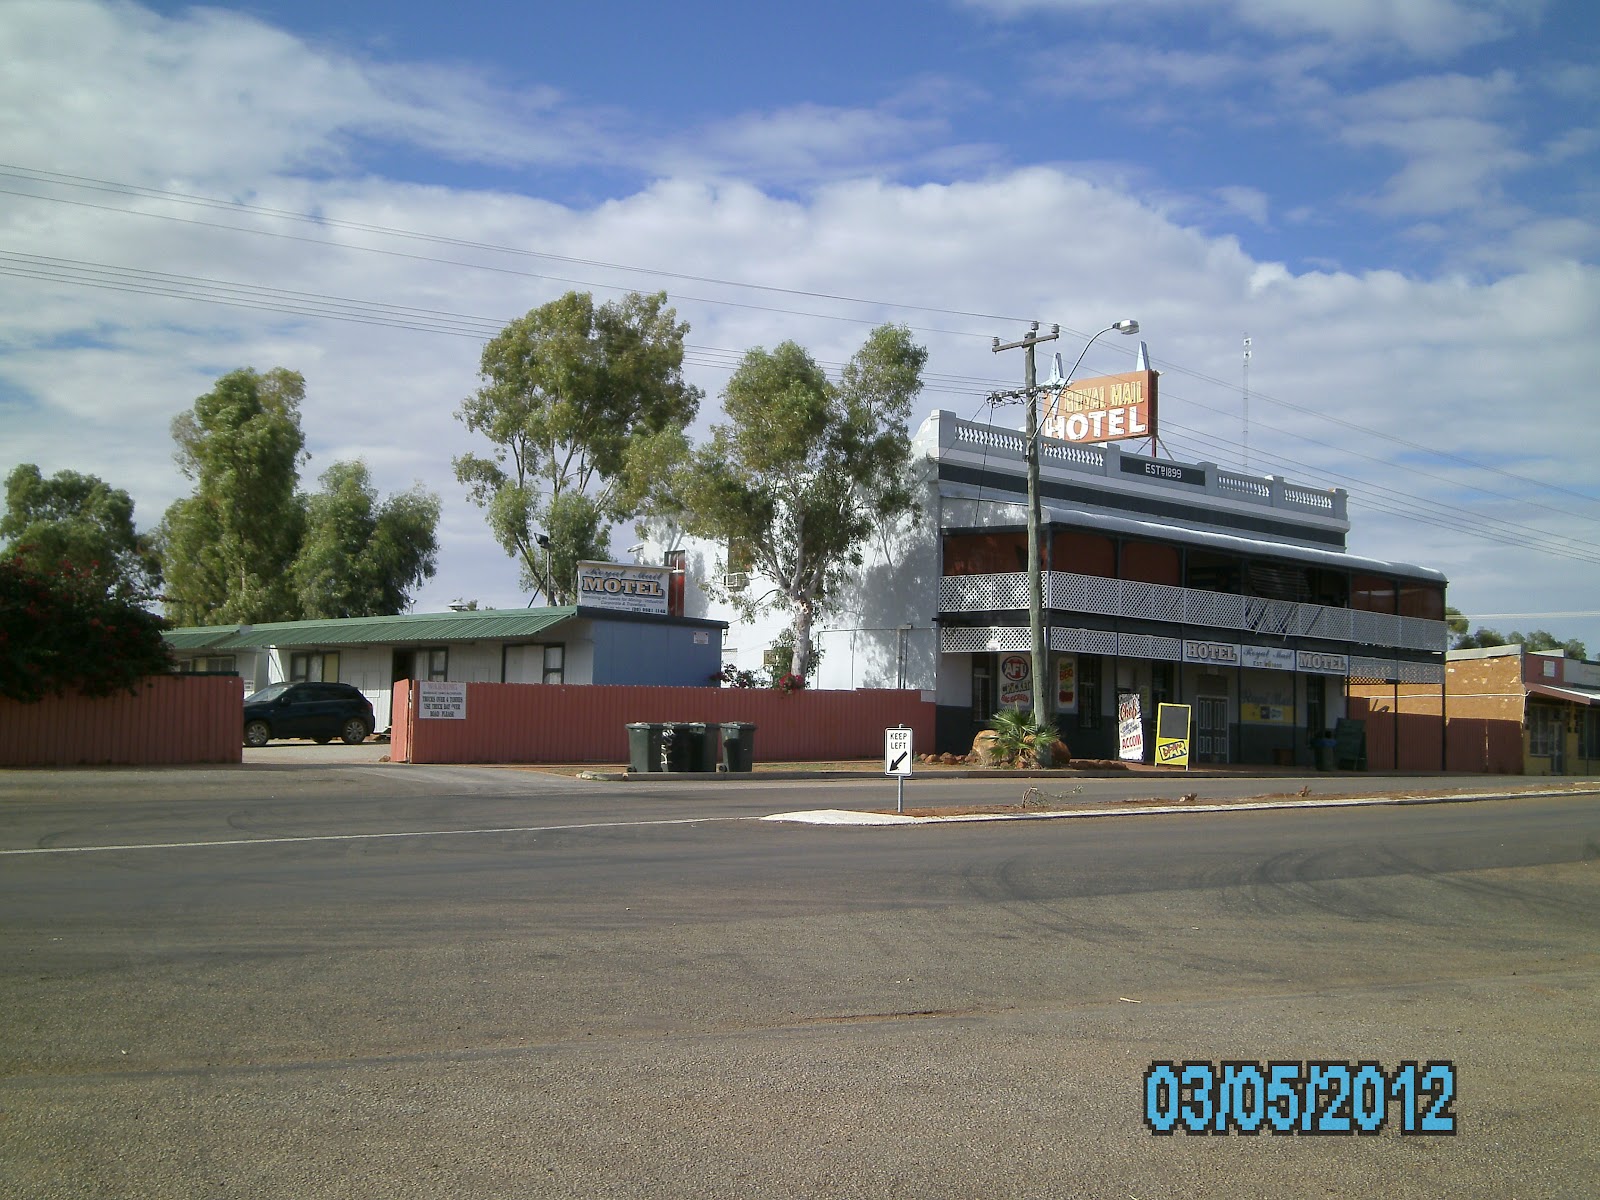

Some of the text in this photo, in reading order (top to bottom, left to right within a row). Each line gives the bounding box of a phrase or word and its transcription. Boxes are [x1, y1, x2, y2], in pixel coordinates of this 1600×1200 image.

[1065, 380, 1144, 412] ROYAL MAIL
[1044, 406, 1146, 440] HOTEL
[582, 576, 664, 598] MOTEL
[1186, 642, 1237, 661] HOTEL
[1004, 662, 1027, 677] AFL
[1299, 653, 1347, 671] MOTEL
[1002, 680, 1030, 695] CRICKET
[890, 732, 908, 740] KEEP
[1122, 733, 1142, 750] ACCOM
